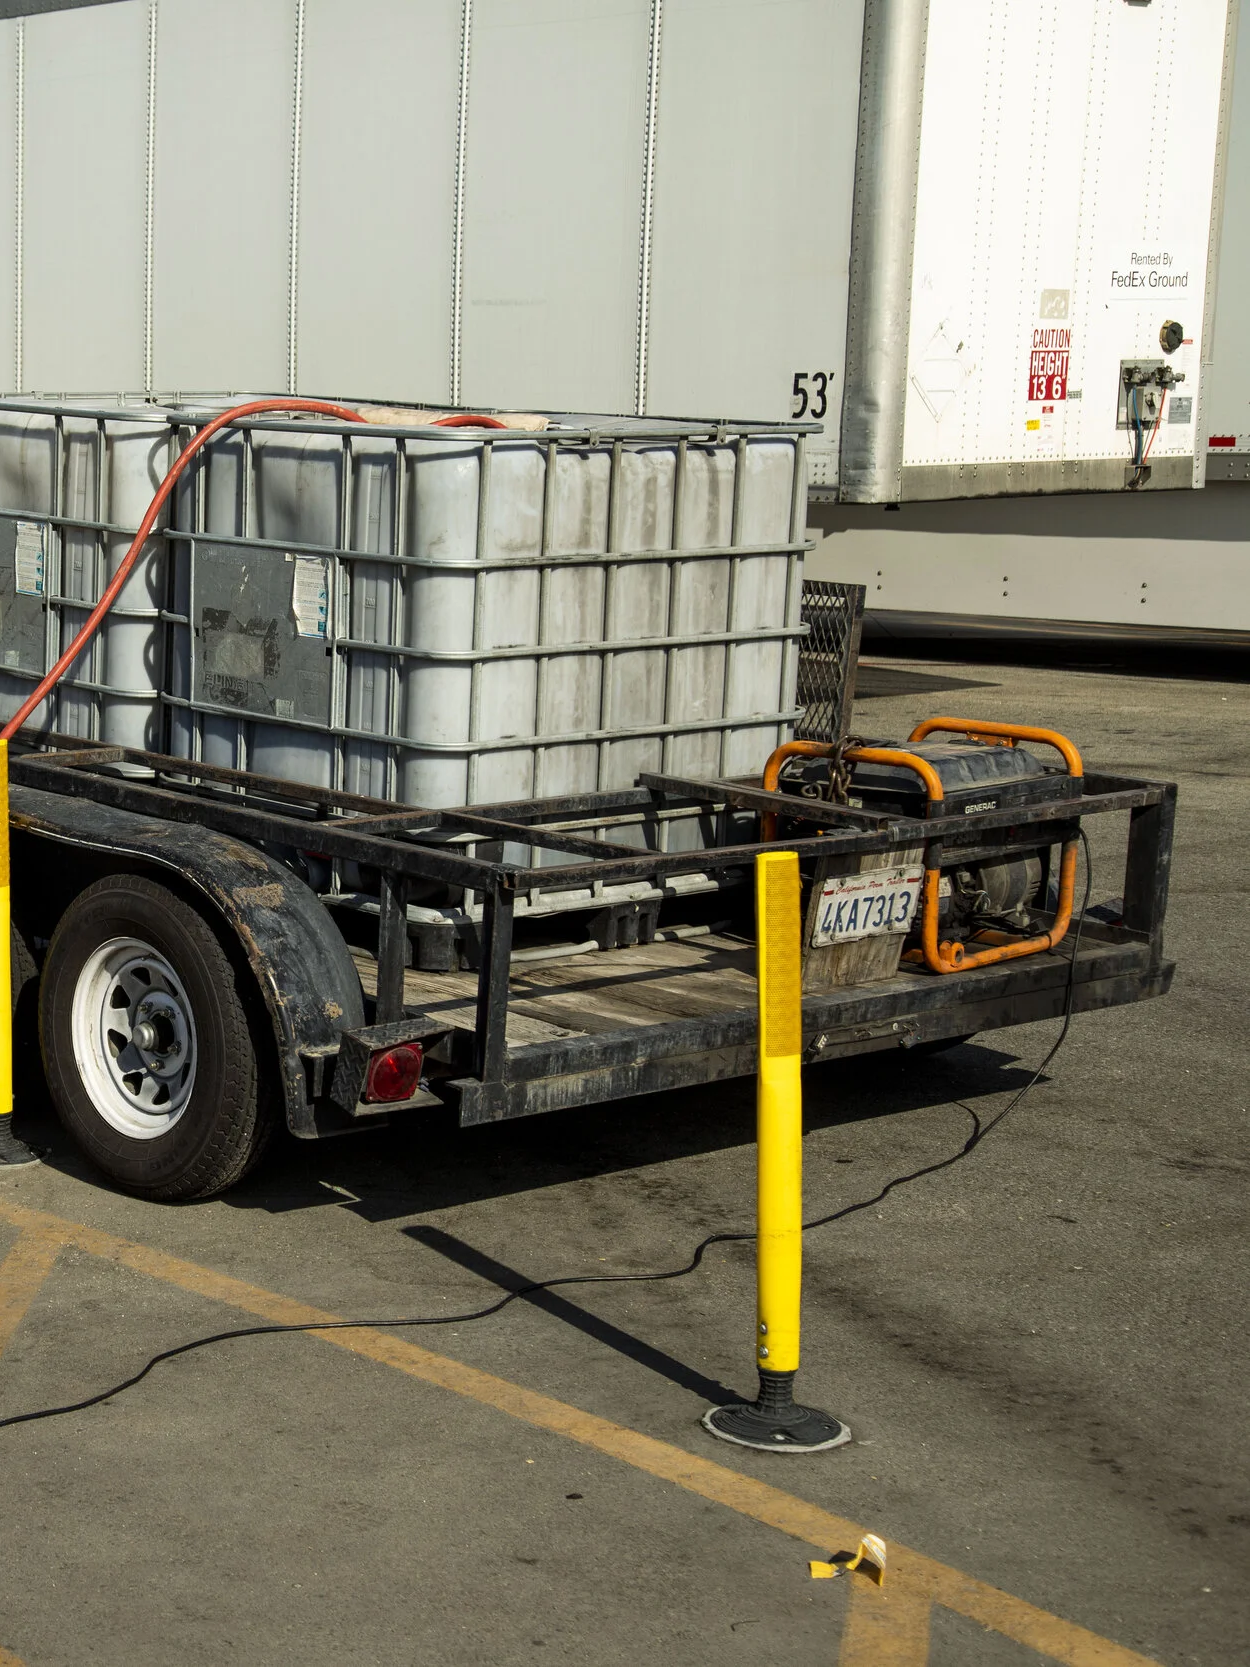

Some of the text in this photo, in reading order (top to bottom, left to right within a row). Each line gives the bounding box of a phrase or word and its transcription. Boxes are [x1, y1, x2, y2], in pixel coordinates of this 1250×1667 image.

[1131, 252, 1173, 267] Rented By
[1111, 270, 1188, 287] FedEx Ground
[1032, 329, 1071, 348] CAUTION
[1031, 352, 1068, 376] HEIGHT
[791, 372, 835, 419] 53'
[965, 801, 997, 814] GENERAC
[820, 891, 912, 934] 4KA7313
